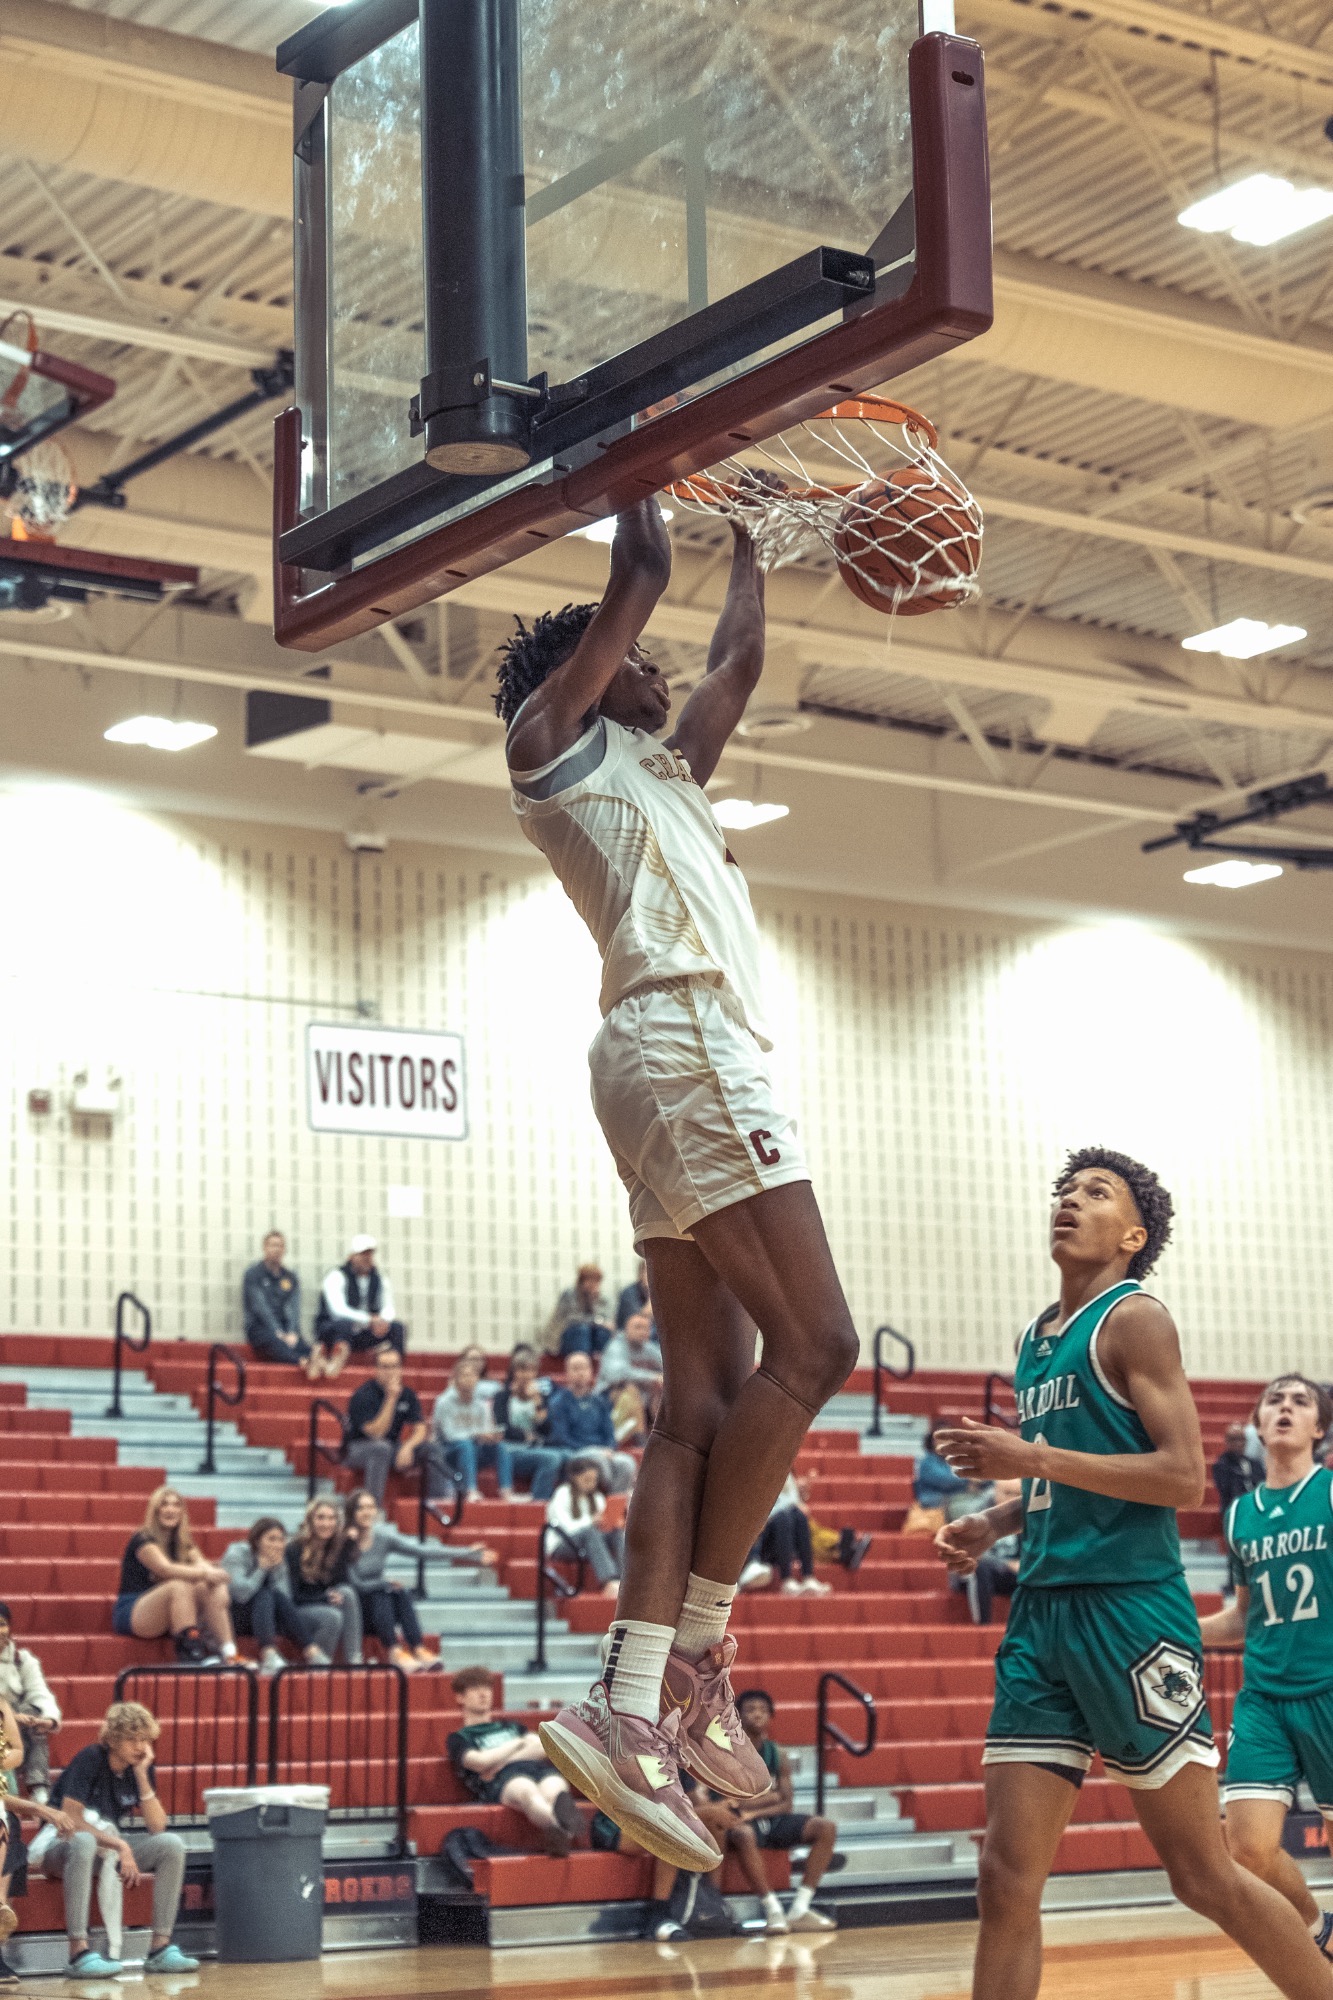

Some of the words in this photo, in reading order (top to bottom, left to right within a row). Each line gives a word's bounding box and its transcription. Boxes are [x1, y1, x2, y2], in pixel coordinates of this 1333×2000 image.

[314, 1049, 458, 1113] VISITORS
[748, 1128, 781, 1165] C
[1240, 1524, 1328, 1567] CARROLL
[1255, 1563, 1319, 1627] 12
